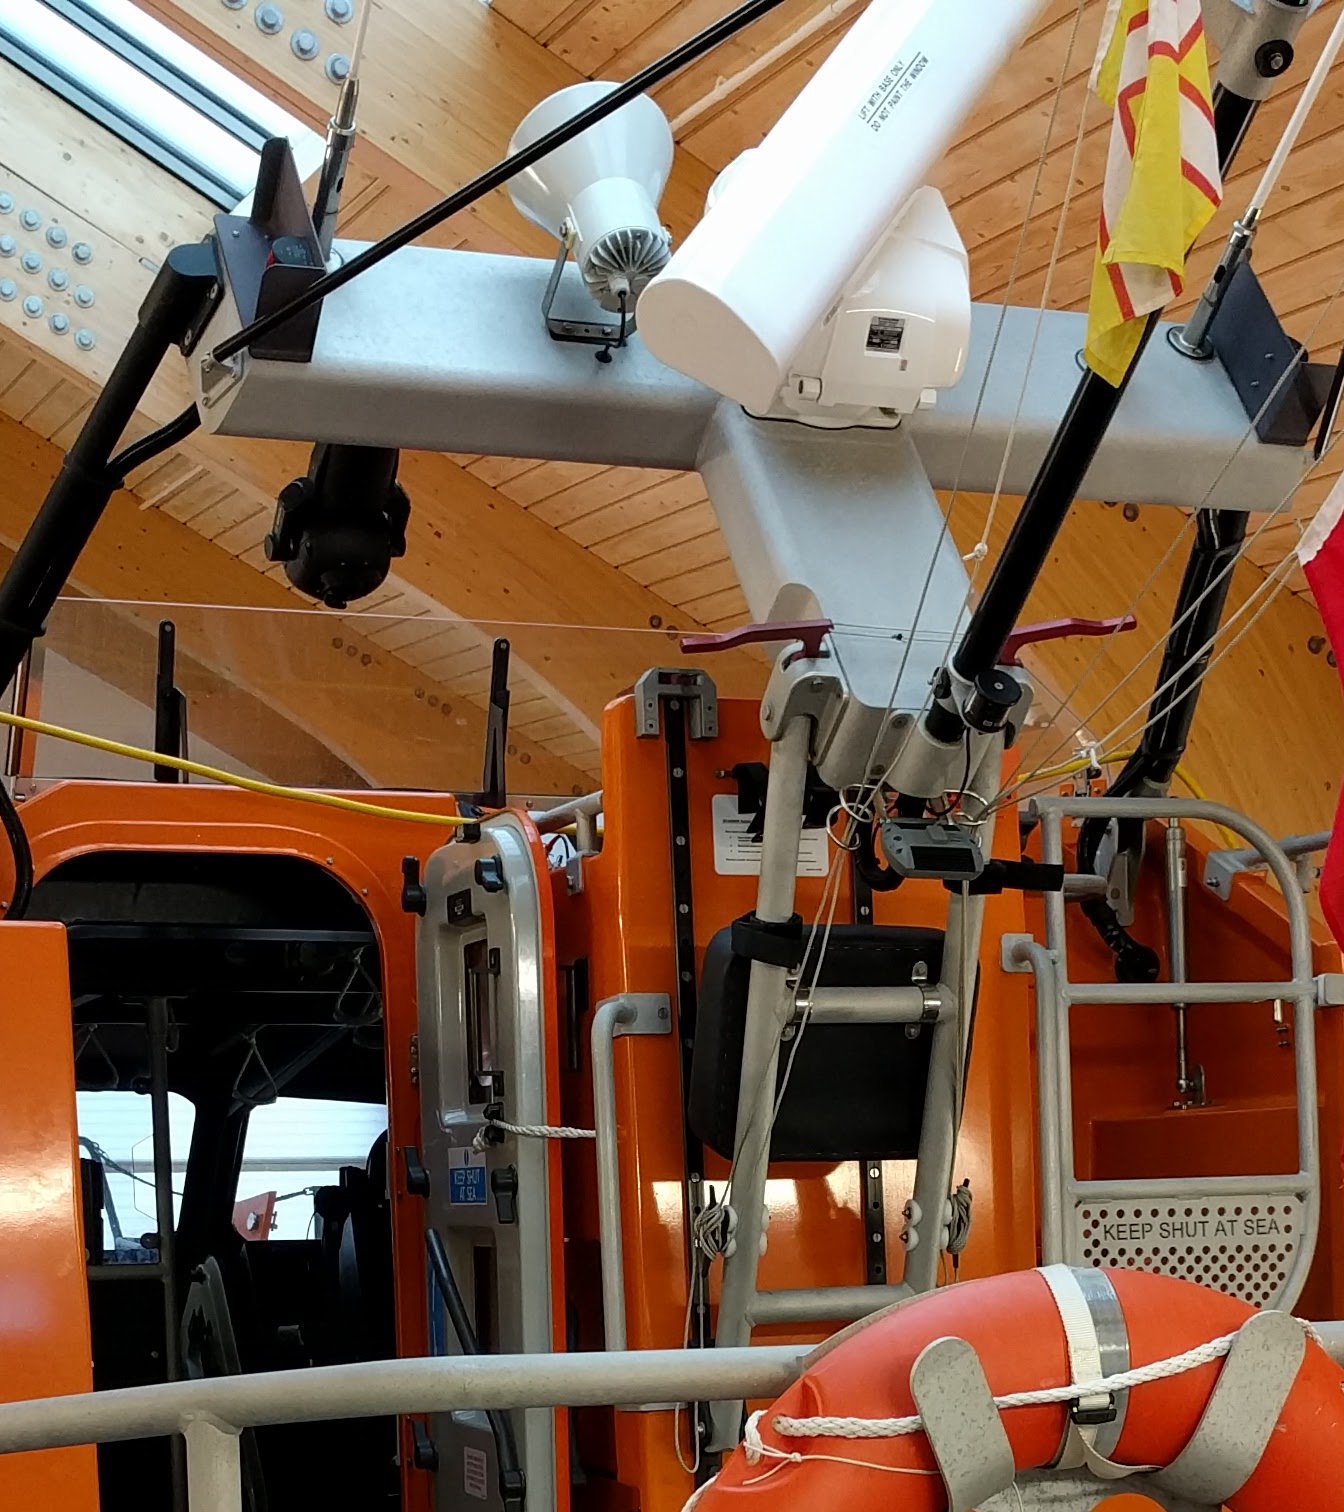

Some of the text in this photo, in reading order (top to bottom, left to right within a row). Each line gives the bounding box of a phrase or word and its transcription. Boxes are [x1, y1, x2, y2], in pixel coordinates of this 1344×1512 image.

[857, 105, 870, 120] LIFT
[867, 91, 882, 107] WITH
[878, 75, 894, 92] BASE
[871, 120, 881, 132] DO
[878, 106, 891, 122] NOT
[887, 90, 903, 109] PAINT
[1103, 1218, 1280, 1241] KEEP SHUT AT SEA
